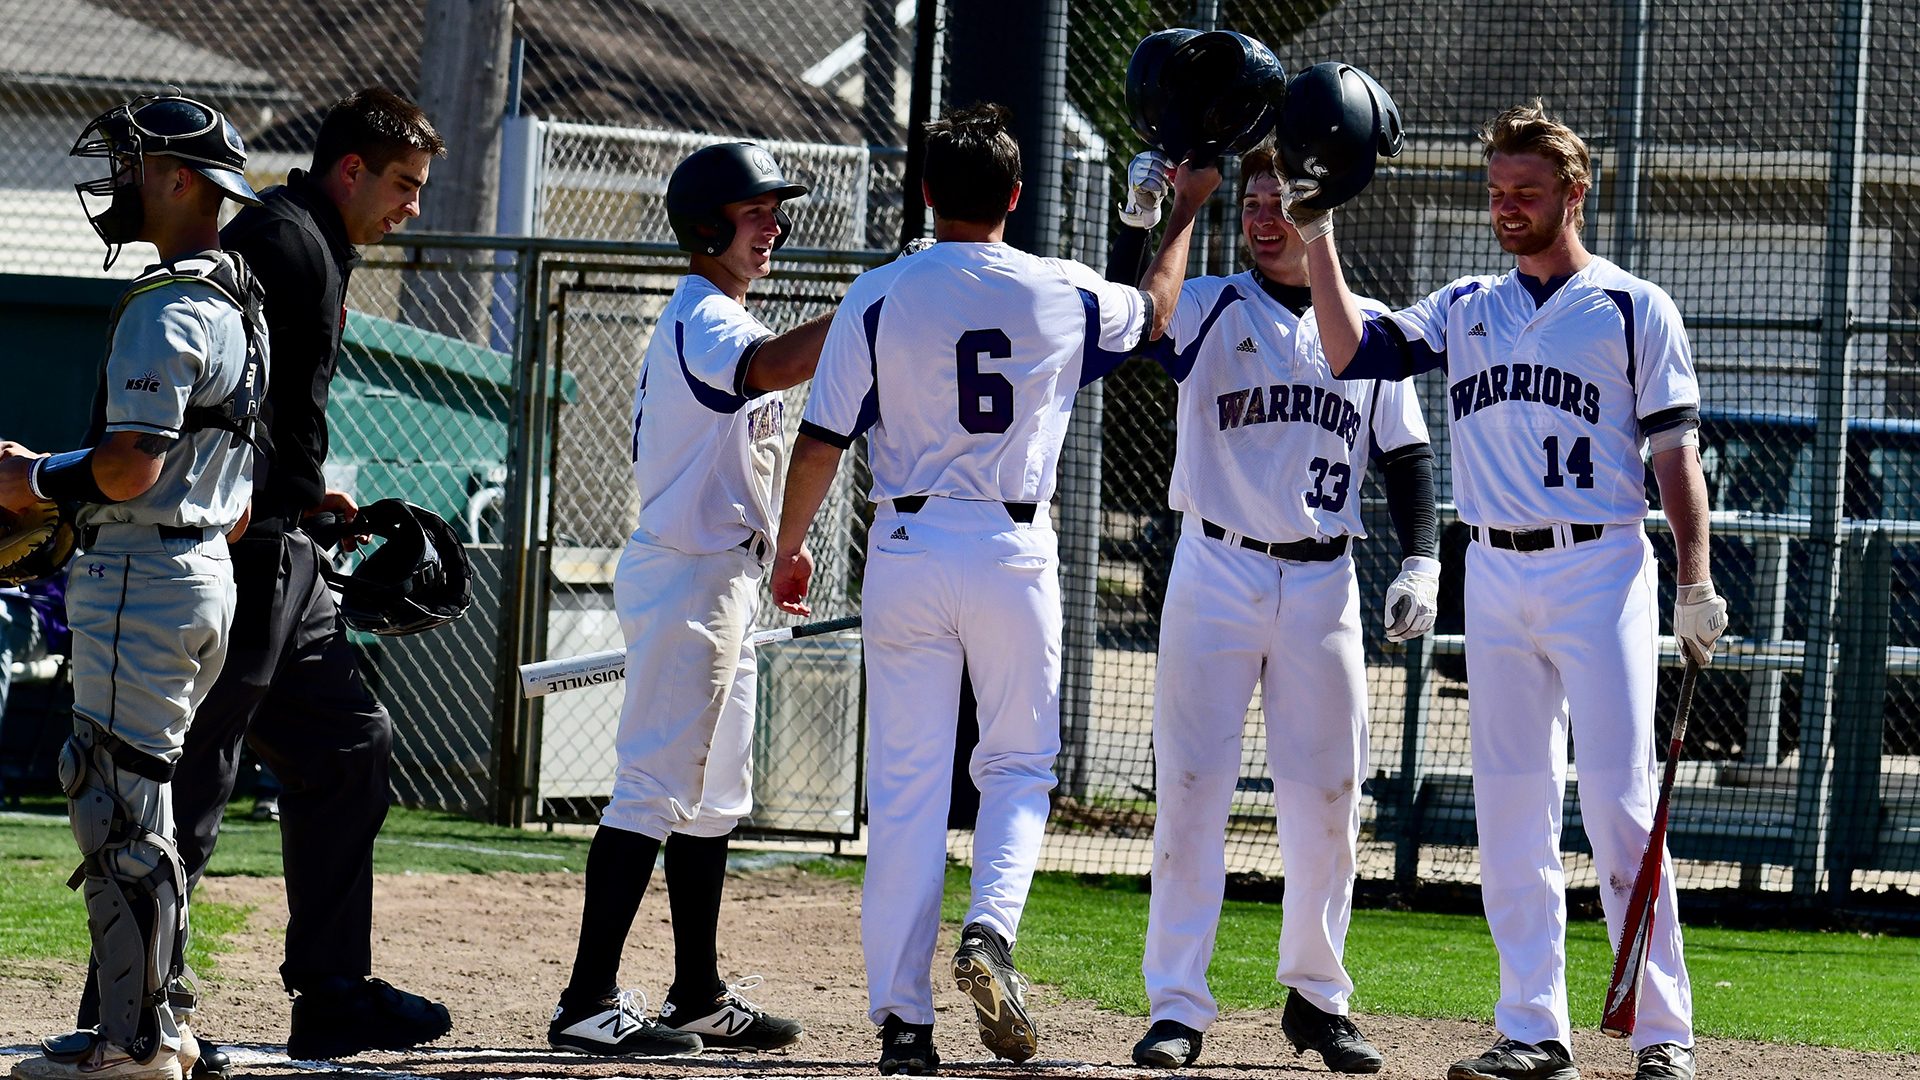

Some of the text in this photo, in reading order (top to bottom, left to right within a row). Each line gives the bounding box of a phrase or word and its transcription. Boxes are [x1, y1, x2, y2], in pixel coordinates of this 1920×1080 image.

[956, 328, 1014, 435] 6
[1450, 363, 1600, 425] WARRIORS
[1217, 384, 1361, 452] WARRIORS
[1305, 456, 1351, 513] 33
[1543, 435, 1594, 489] 14
